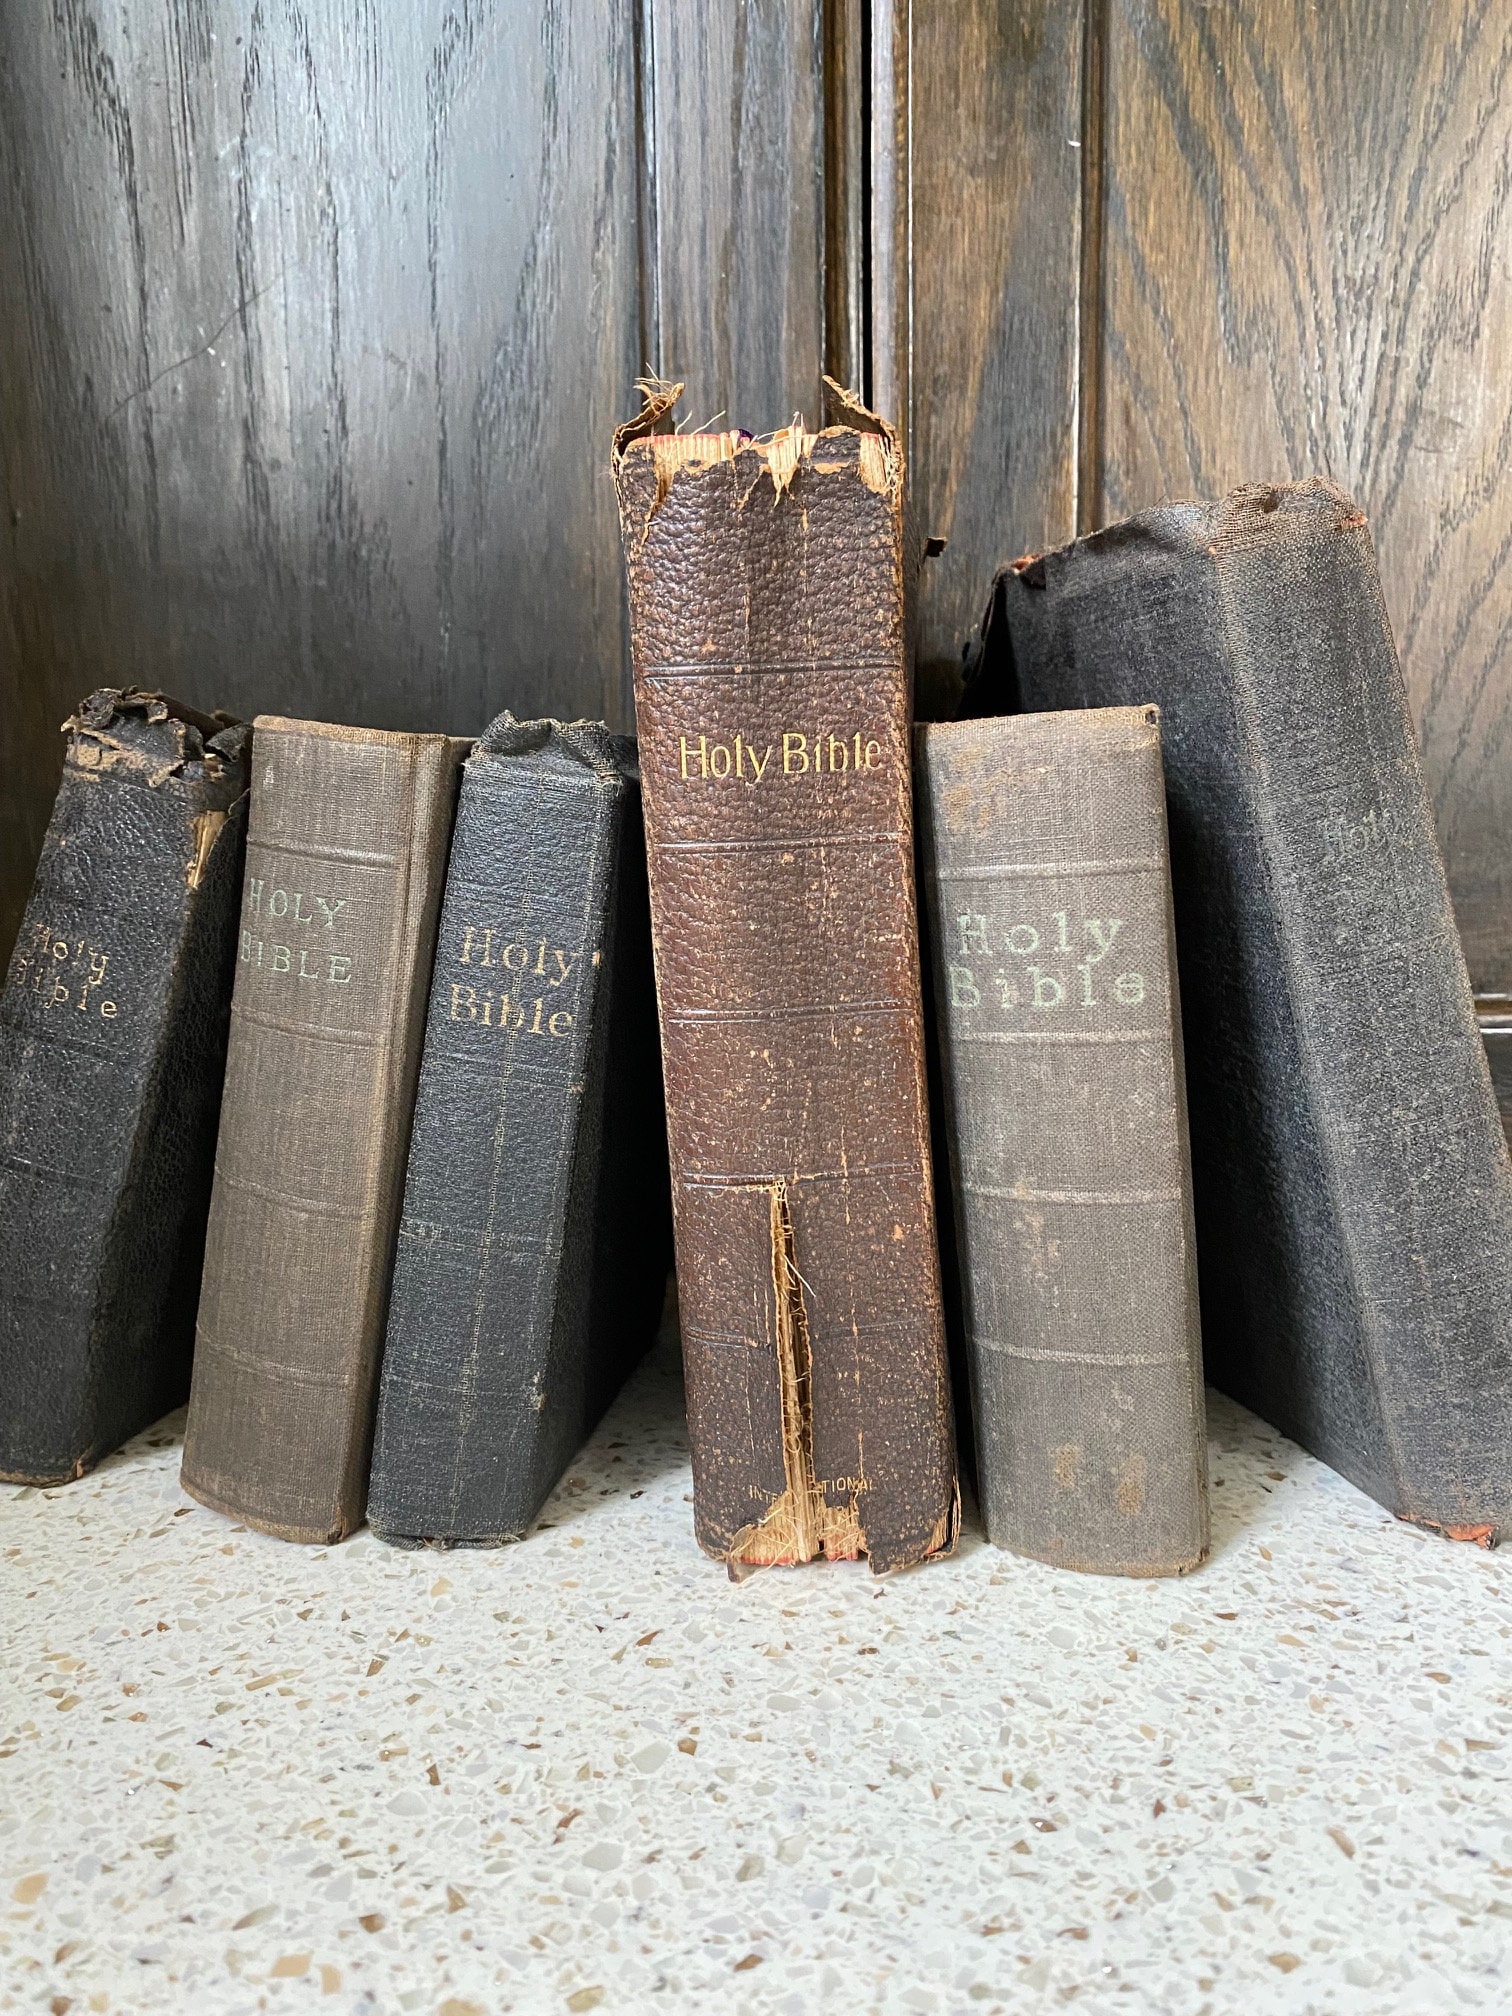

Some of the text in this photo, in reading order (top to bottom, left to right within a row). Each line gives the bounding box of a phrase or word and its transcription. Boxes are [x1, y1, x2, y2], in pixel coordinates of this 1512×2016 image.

[679, 731, 883, 787] Holy Bible
[249, 877, 347, 928] HOLY
[240, 929, 352, 984] BIBLE
[459, 924, 580, 987] Holy
[956, 911, 1123, 963] Holy
[450, 982, 574, 1038] Bible
[949, 964, 1145, 1009] Bible
[748, 1475, 874, 1505] INTETIONAL
